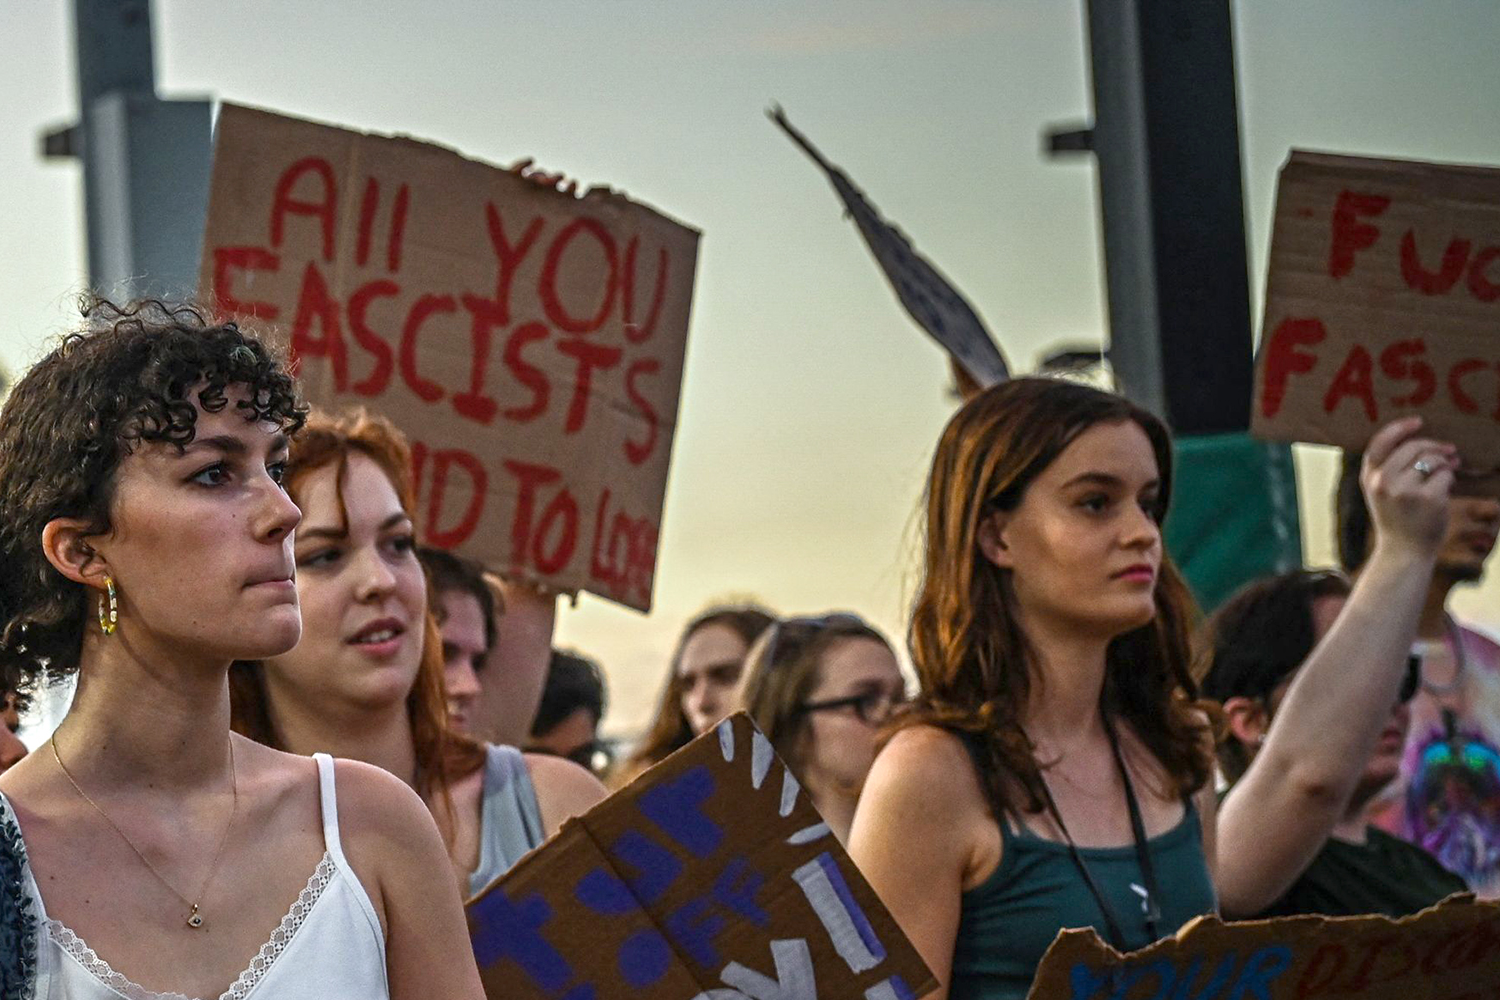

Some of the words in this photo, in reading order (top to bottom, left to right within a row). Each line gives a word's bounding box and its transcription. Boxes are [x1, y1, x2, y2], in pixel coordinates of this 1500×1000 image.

[485, 200, 669, 344] YOU
[212, 246, 662, 465] FASCISTS
[1261, 316, 1500, 424] FASC
[502, 459, 580, 577] TO
[616, 853, 771, 989] OFF
